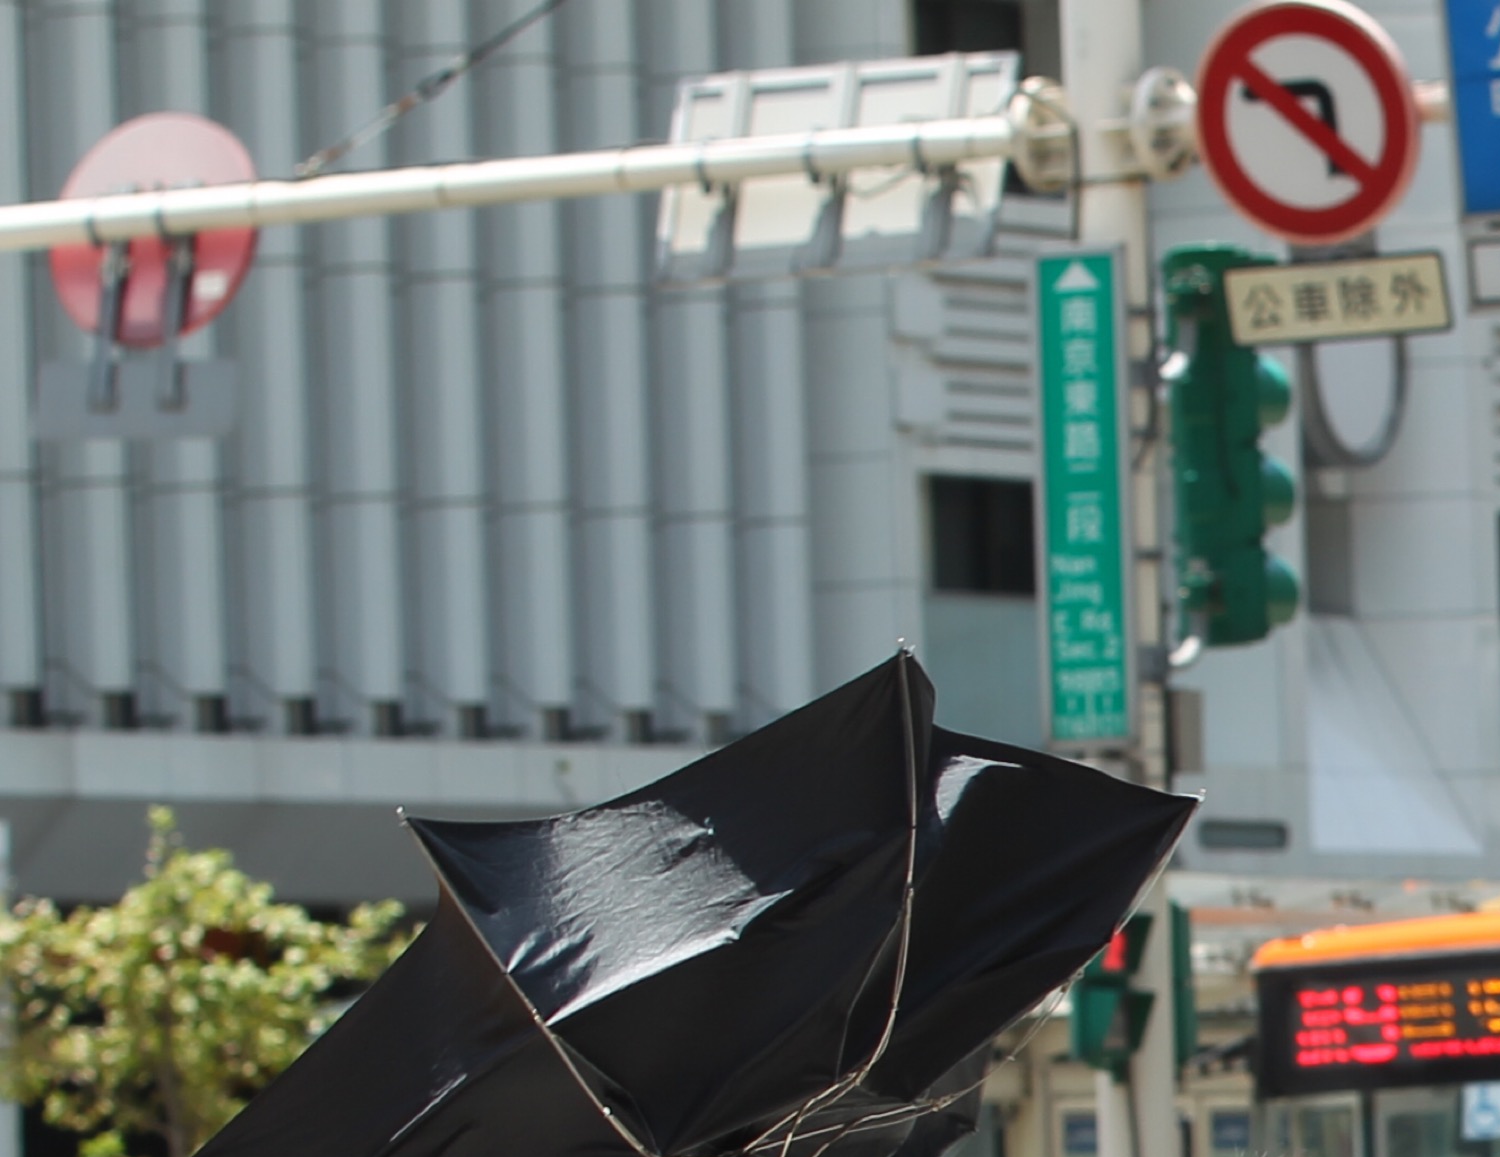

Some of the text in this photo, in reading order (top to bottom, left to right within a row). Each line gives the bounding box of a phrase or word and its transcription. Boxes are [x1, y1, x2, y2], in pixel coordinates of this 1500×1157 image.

[1244, 269, 1430, 328] 公車除外
[1060, 296, 1105, 543] 南京東路二段
